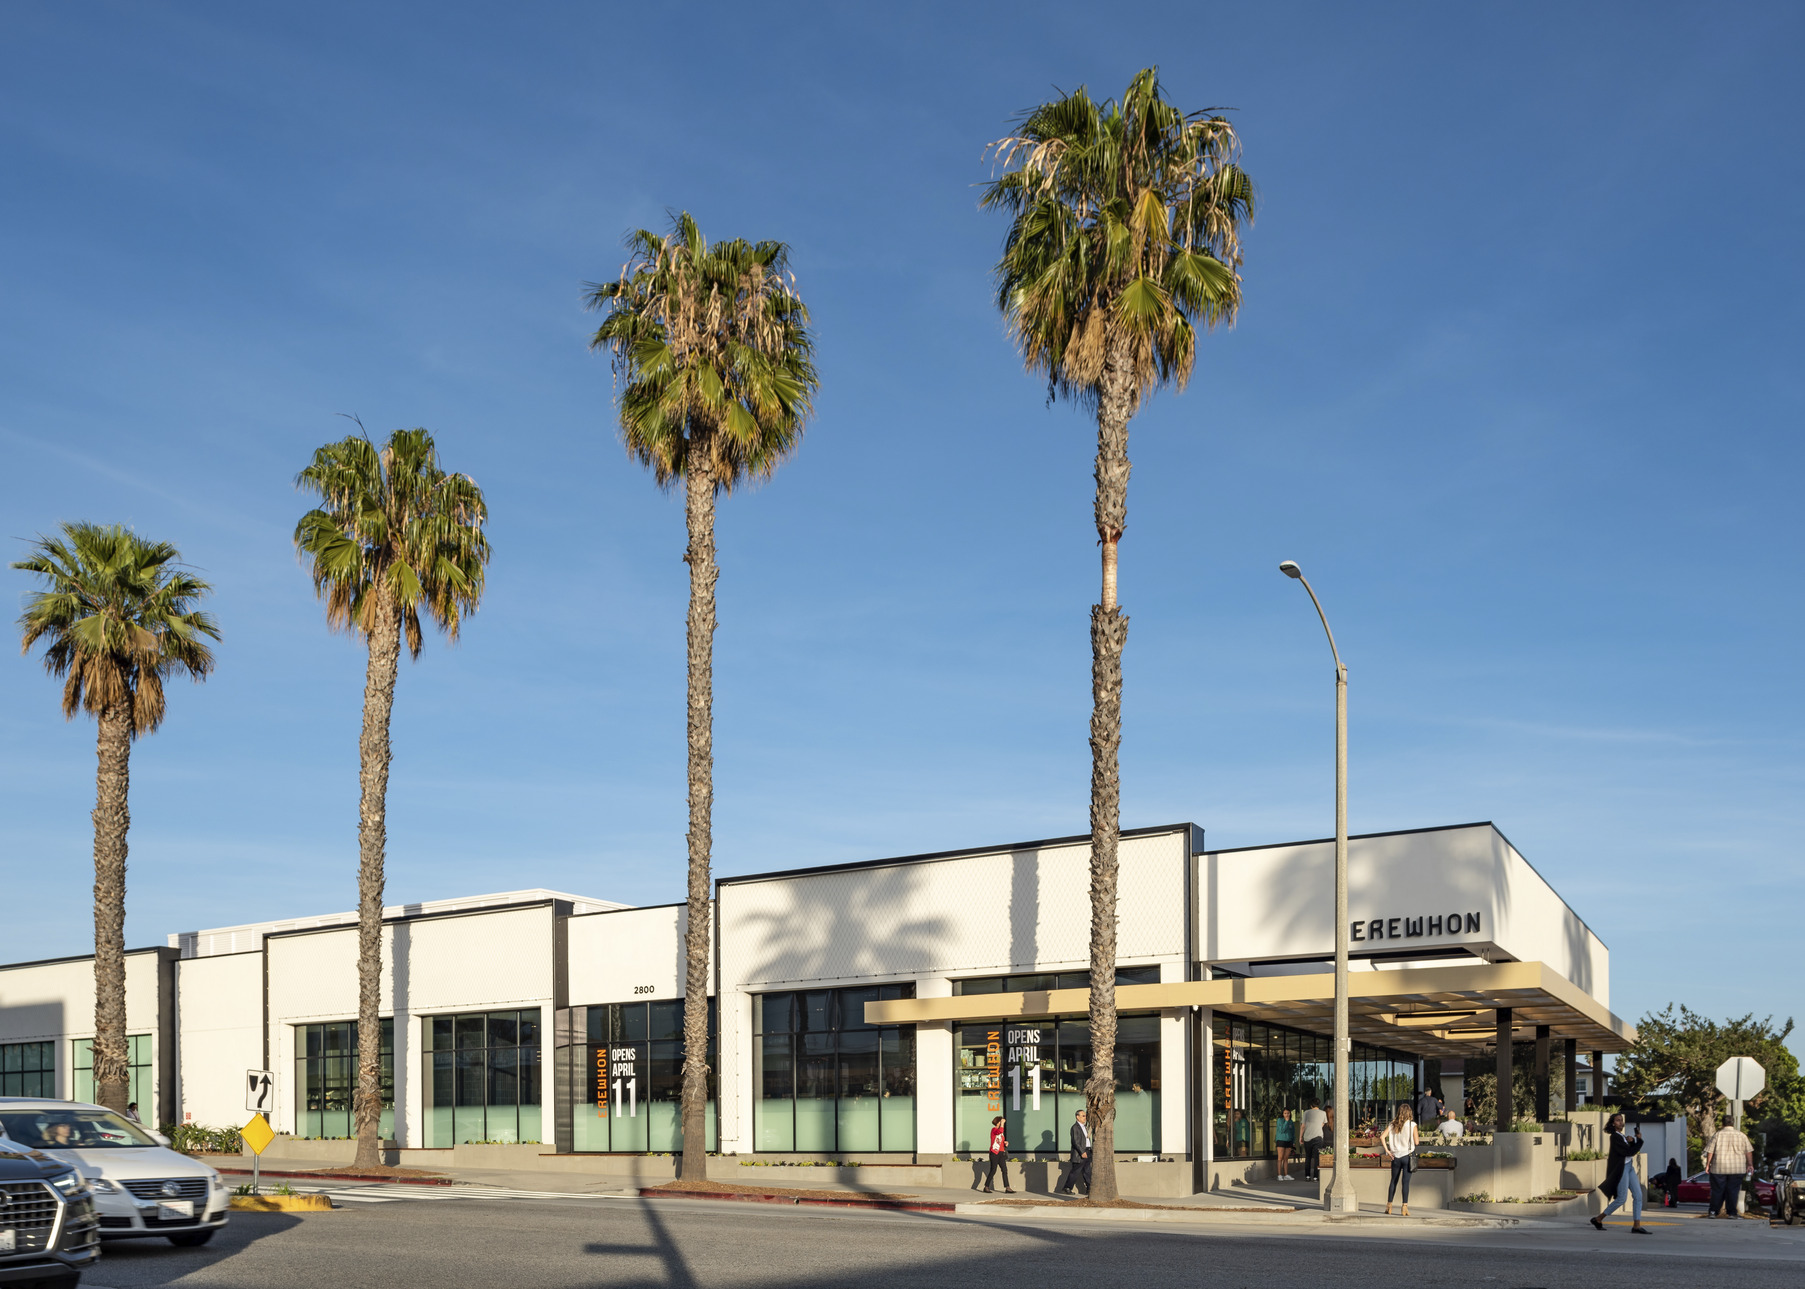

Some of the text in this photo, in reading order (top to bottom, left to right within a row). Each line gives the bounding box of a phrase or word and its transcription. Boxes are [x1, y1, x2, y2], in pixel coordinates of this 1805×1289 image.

[1352, 912, 1480, 941] EREWHON
[634, 985, 655, 994] 2800
[1008, 1030, 1040, 1044] OPENS
[612, 1048, 636, 1061] OPENS
[1008, 1046, 1040, 1062] APRIL
[597, 1049, 607, 1118] EREWHON
[612, 1063, 636, 1077] APRIL
[987, 1031, 1000, 1111] EREWHON
[612, 1078, 636, 1118] 11
[1008, 1065, 1040, 1110] 11
[1233, 1063, 1245, 1110] 11
